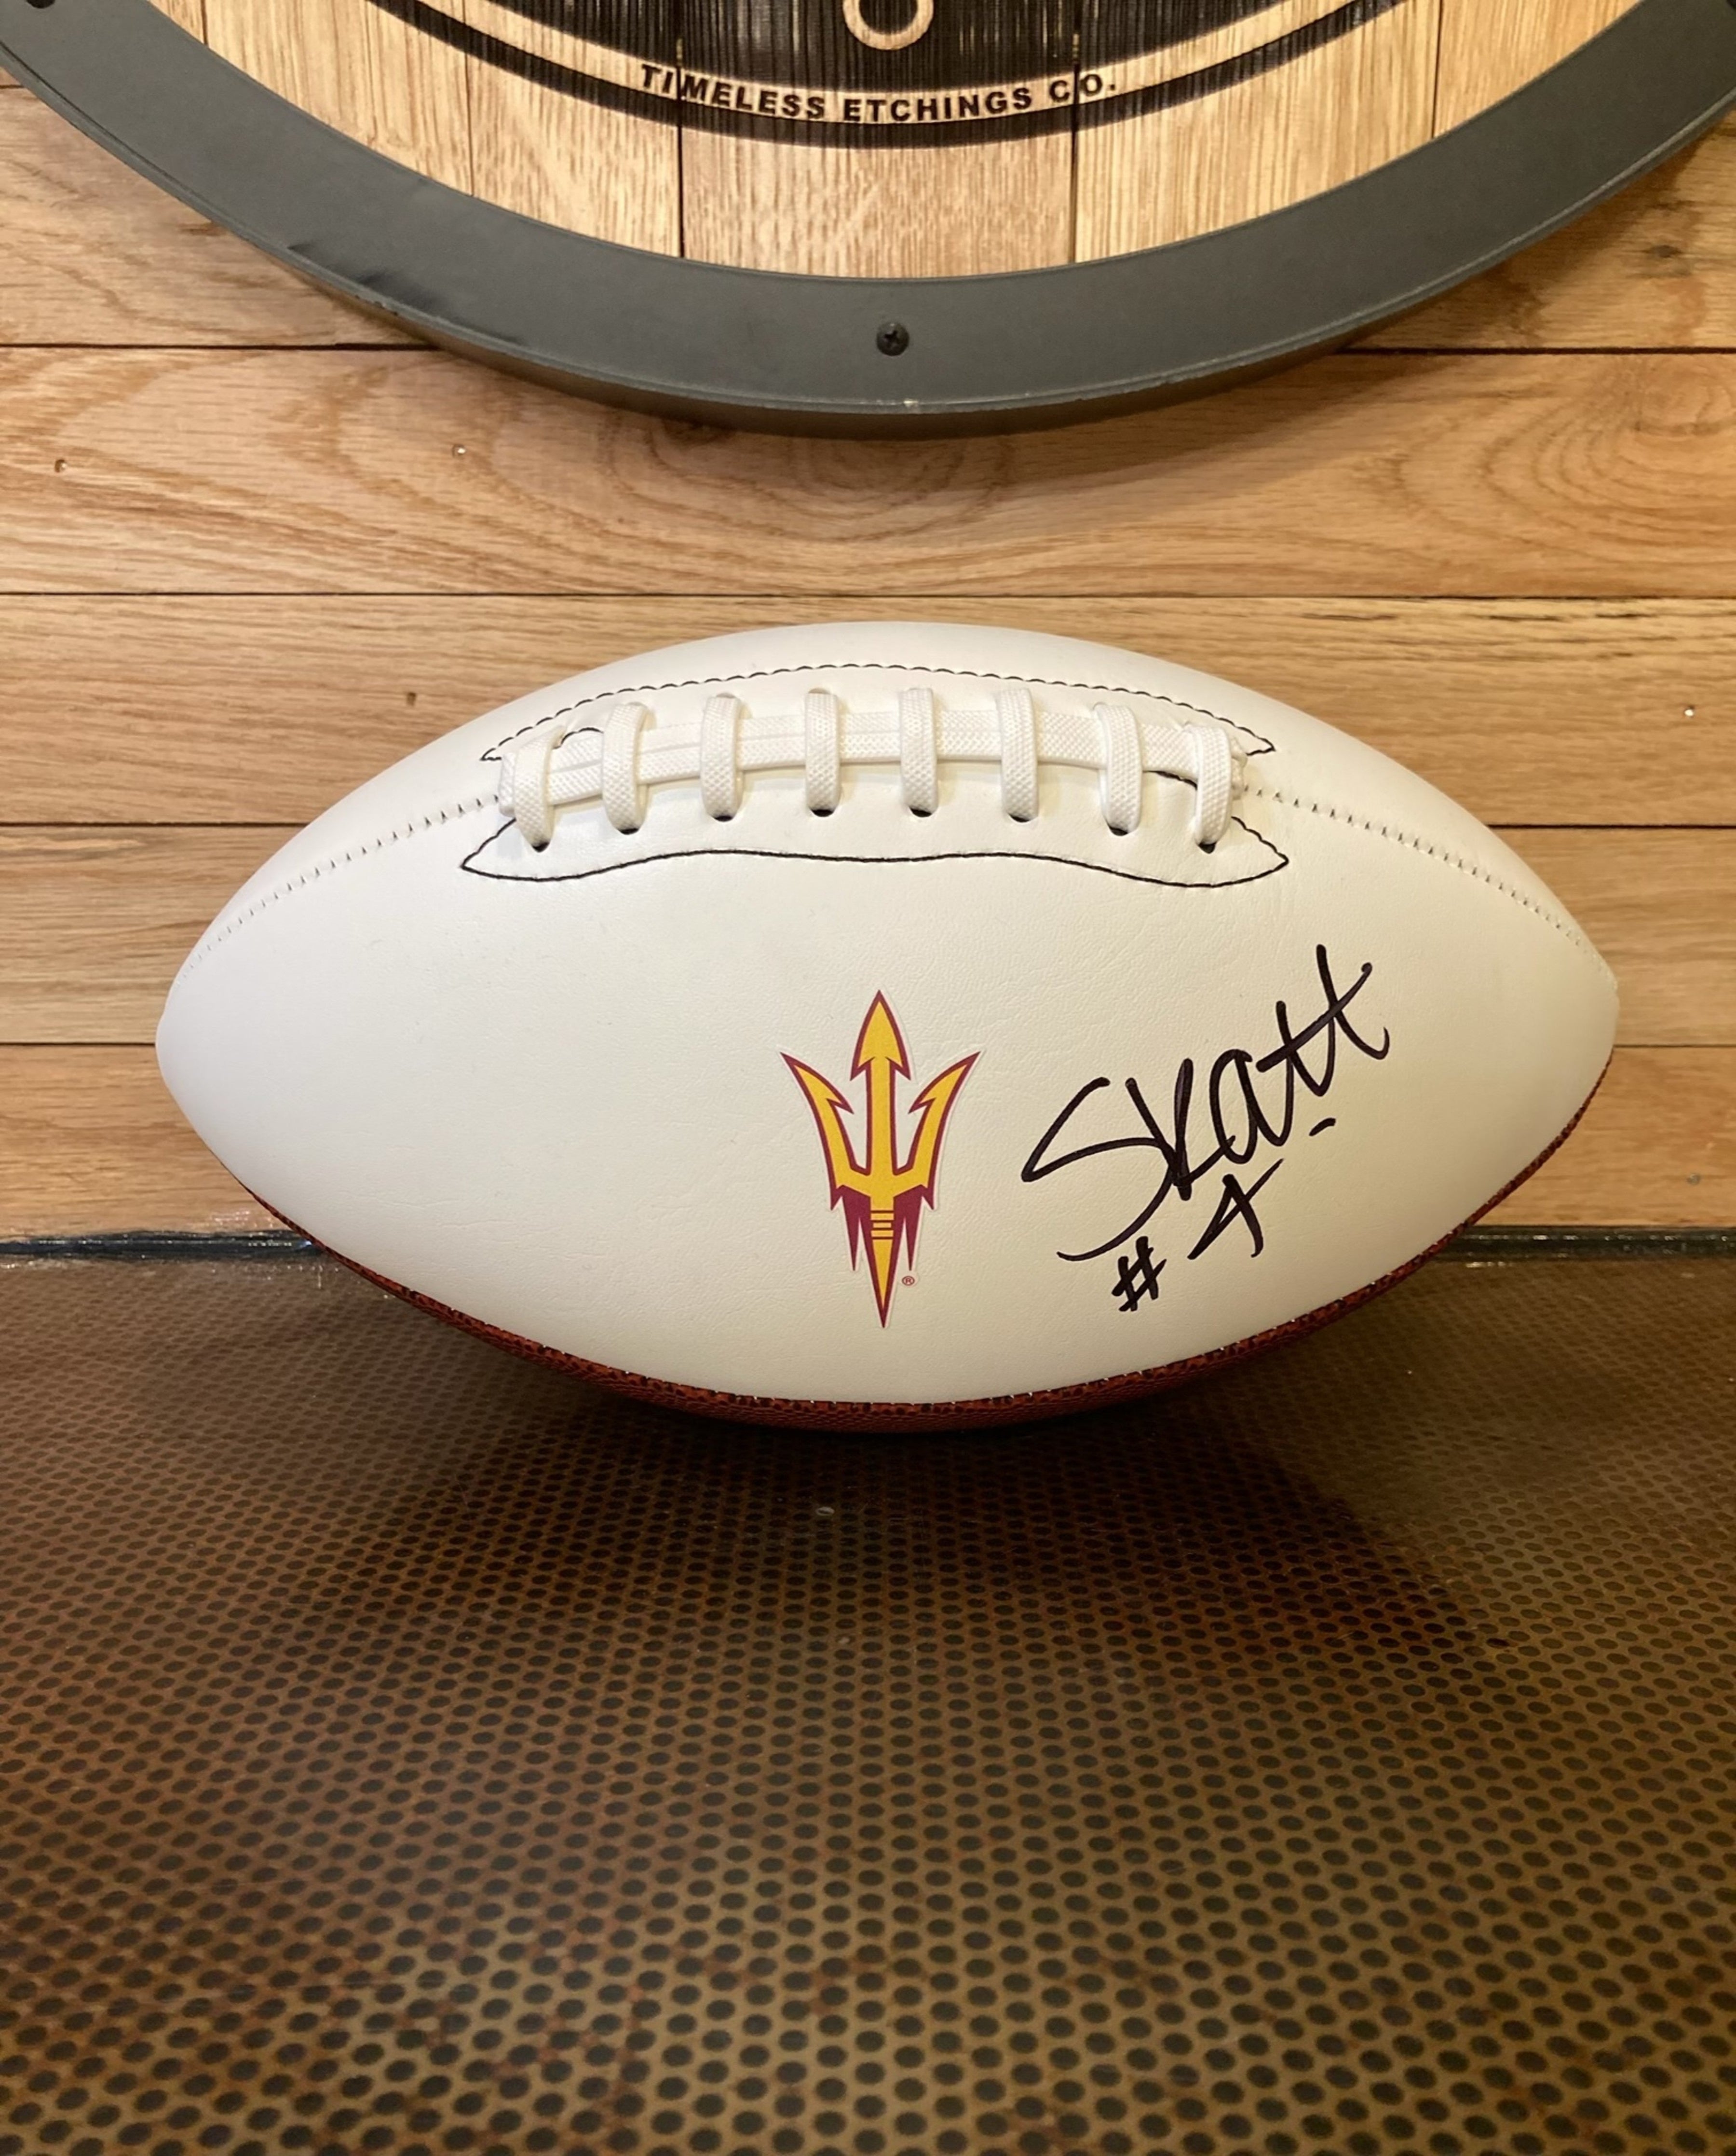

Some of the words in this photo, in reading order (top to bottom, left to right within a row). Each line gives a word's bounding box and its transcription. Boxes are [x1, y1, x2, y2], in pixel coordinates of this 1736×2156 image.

[641, 64, 825, 119] TIMELESS
[843, 87, 1032, 122] ETCHINGS
[1049, 73, 1116, 103] CO.
